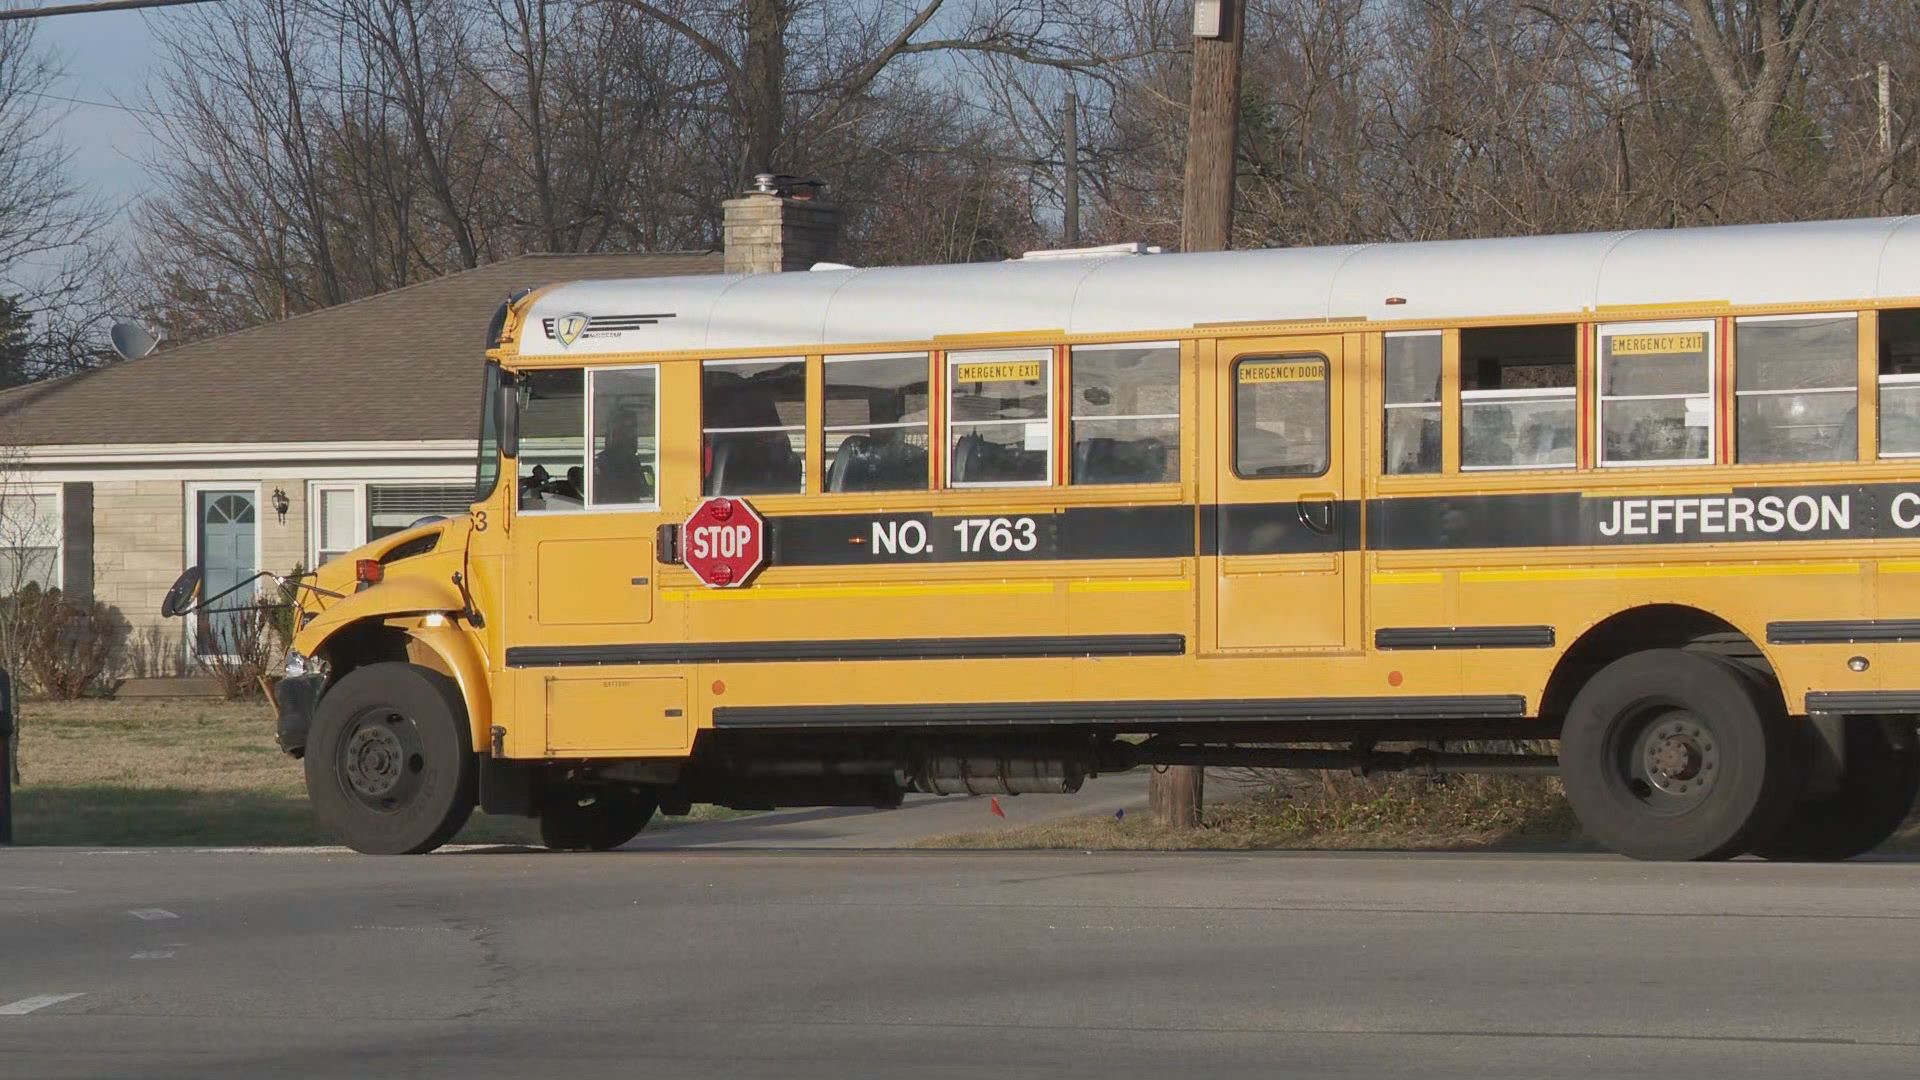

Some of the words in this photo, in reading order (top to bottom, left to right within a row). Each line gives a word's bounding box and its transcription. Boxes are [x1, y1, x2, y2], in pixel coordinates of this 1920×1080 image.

[1612, 336, 1674, 352] EMERGENCY
[1680, 336, 1702, 349] EXIT
[958, 365, 1014, 379] EMERGENCY
[1019, 364, 1038, 377] EXIT
[1239, 366, 1295, 380] EMERGENCY
[1298, 365, 1325, 378] DOOR
[1599, 494, 1850, 536] JEFFERSON
[1890, 492, 1920, 529] C
[693, 525, 751, 559] STOP
[872, 519, 934, 555] NO.
[953, 517, 1038, 553] 1763
